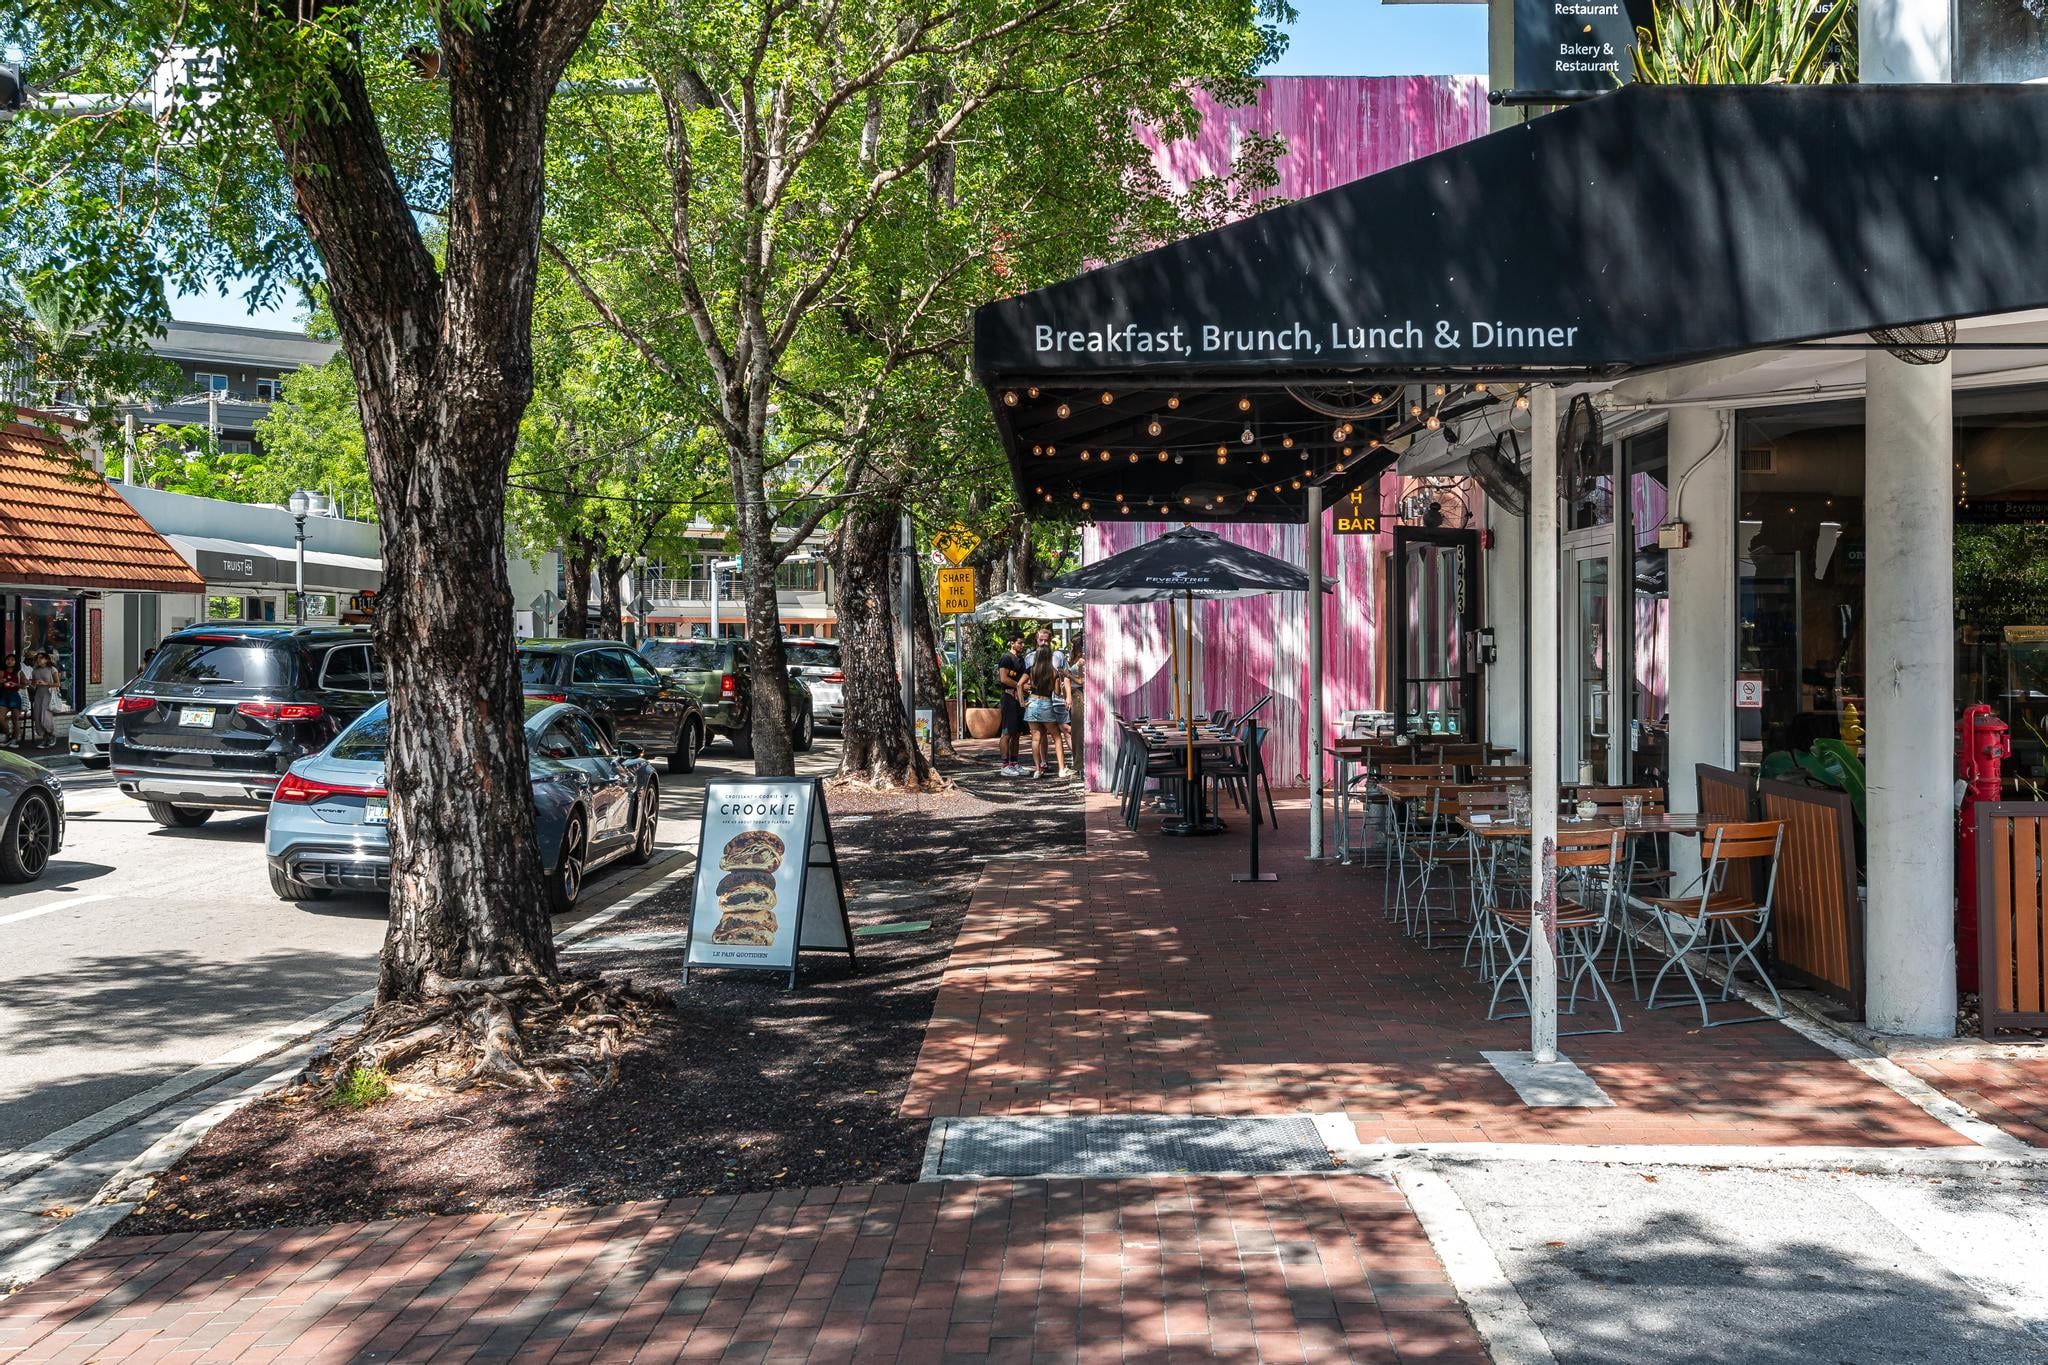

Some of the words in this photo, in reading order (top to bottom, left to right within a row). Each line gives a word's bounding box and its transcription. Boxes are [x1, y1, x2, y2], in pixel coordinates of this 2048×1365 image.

[1555, 3, 1619, 15] Restaurant
[1560, 43, 1601, 58] Bakery
[1603, 42, 1614, 55] &
[1555, 60, 1619, 72] Restaurant
[1035, 324, 1193, 357] Breakfast,
[1202, 322, 1322, 354] Brunch,
[1331, 321, 1423, 350] Lunch
[1434, 321, 1460, 349] &
[1472, 320, 1579, 348] Dinner
[1338, 518, 1376, 531] BAR
[223, 560, 244, 572] TRUIST
[943, 573, 970, 583] SHARE
[1457, 545, 1465, 613] 3423
[949, 586, 965, 595] THE
[946, 599, 969, 609] ROAD
[720, 803, 796, 816] CROOKIE
